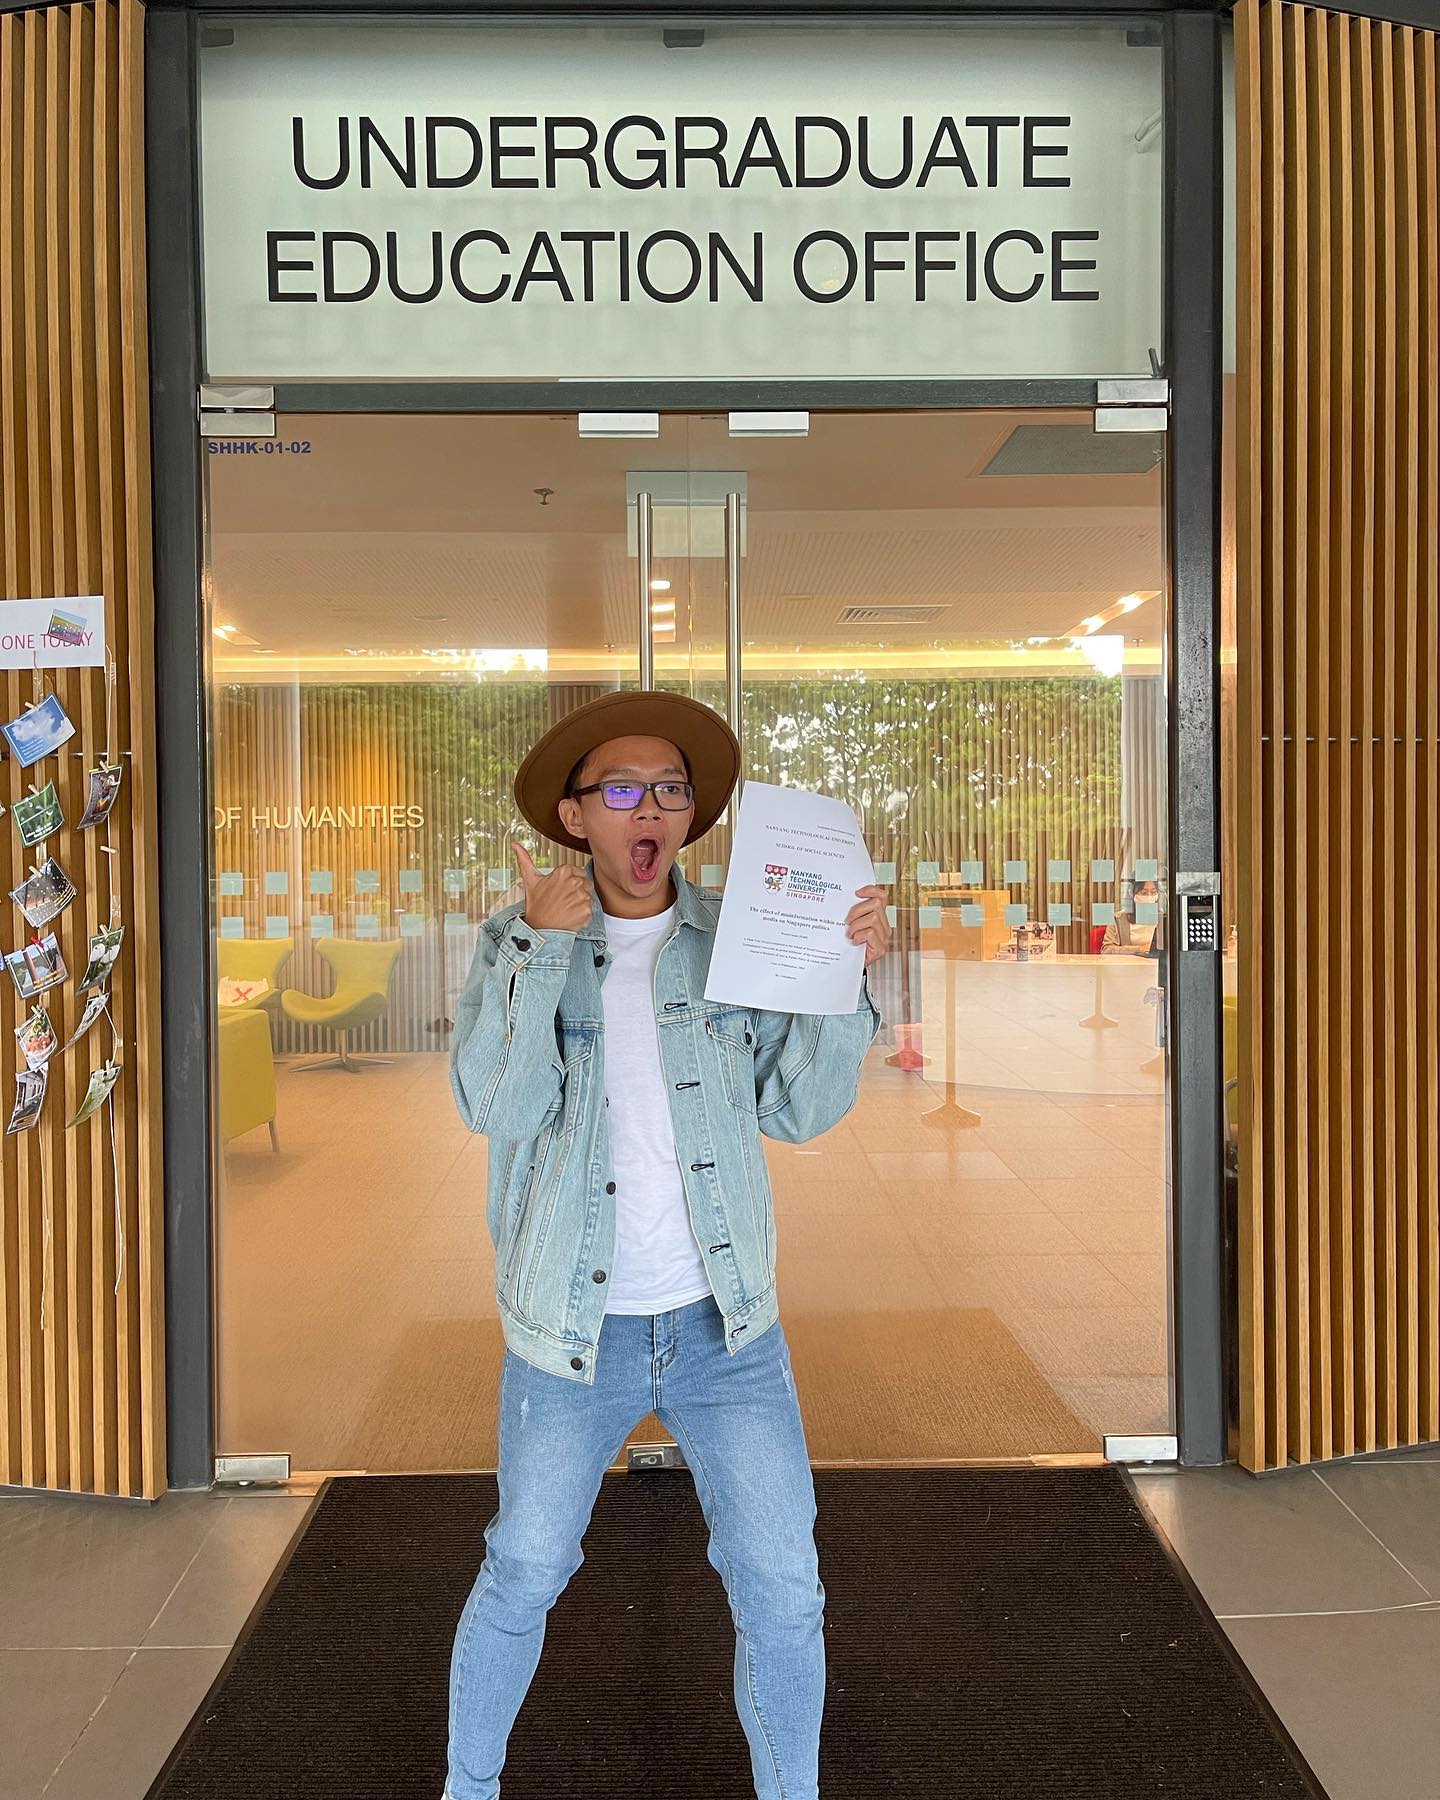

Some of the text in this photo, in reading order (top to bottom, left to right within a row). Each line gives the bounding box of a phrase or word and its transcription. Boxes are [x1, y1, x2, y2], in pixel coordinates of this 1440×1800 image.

[292, 115, 1071, 190] UNDERGRADUATE
[266, 229, 1100, 304] EDUCATION OFFICE
[207, 441, 311, 454] SHHK-01-02
[251, 805, 425, 829] HUMANITIES
[790, 869, 822, 880] NANYANG
[787, 883, 827, 894] UNIVERSITY
[790, 876, 842, 891] TECHNOLOGICAL
[786, 892, 825, 902] SINGAPORE
